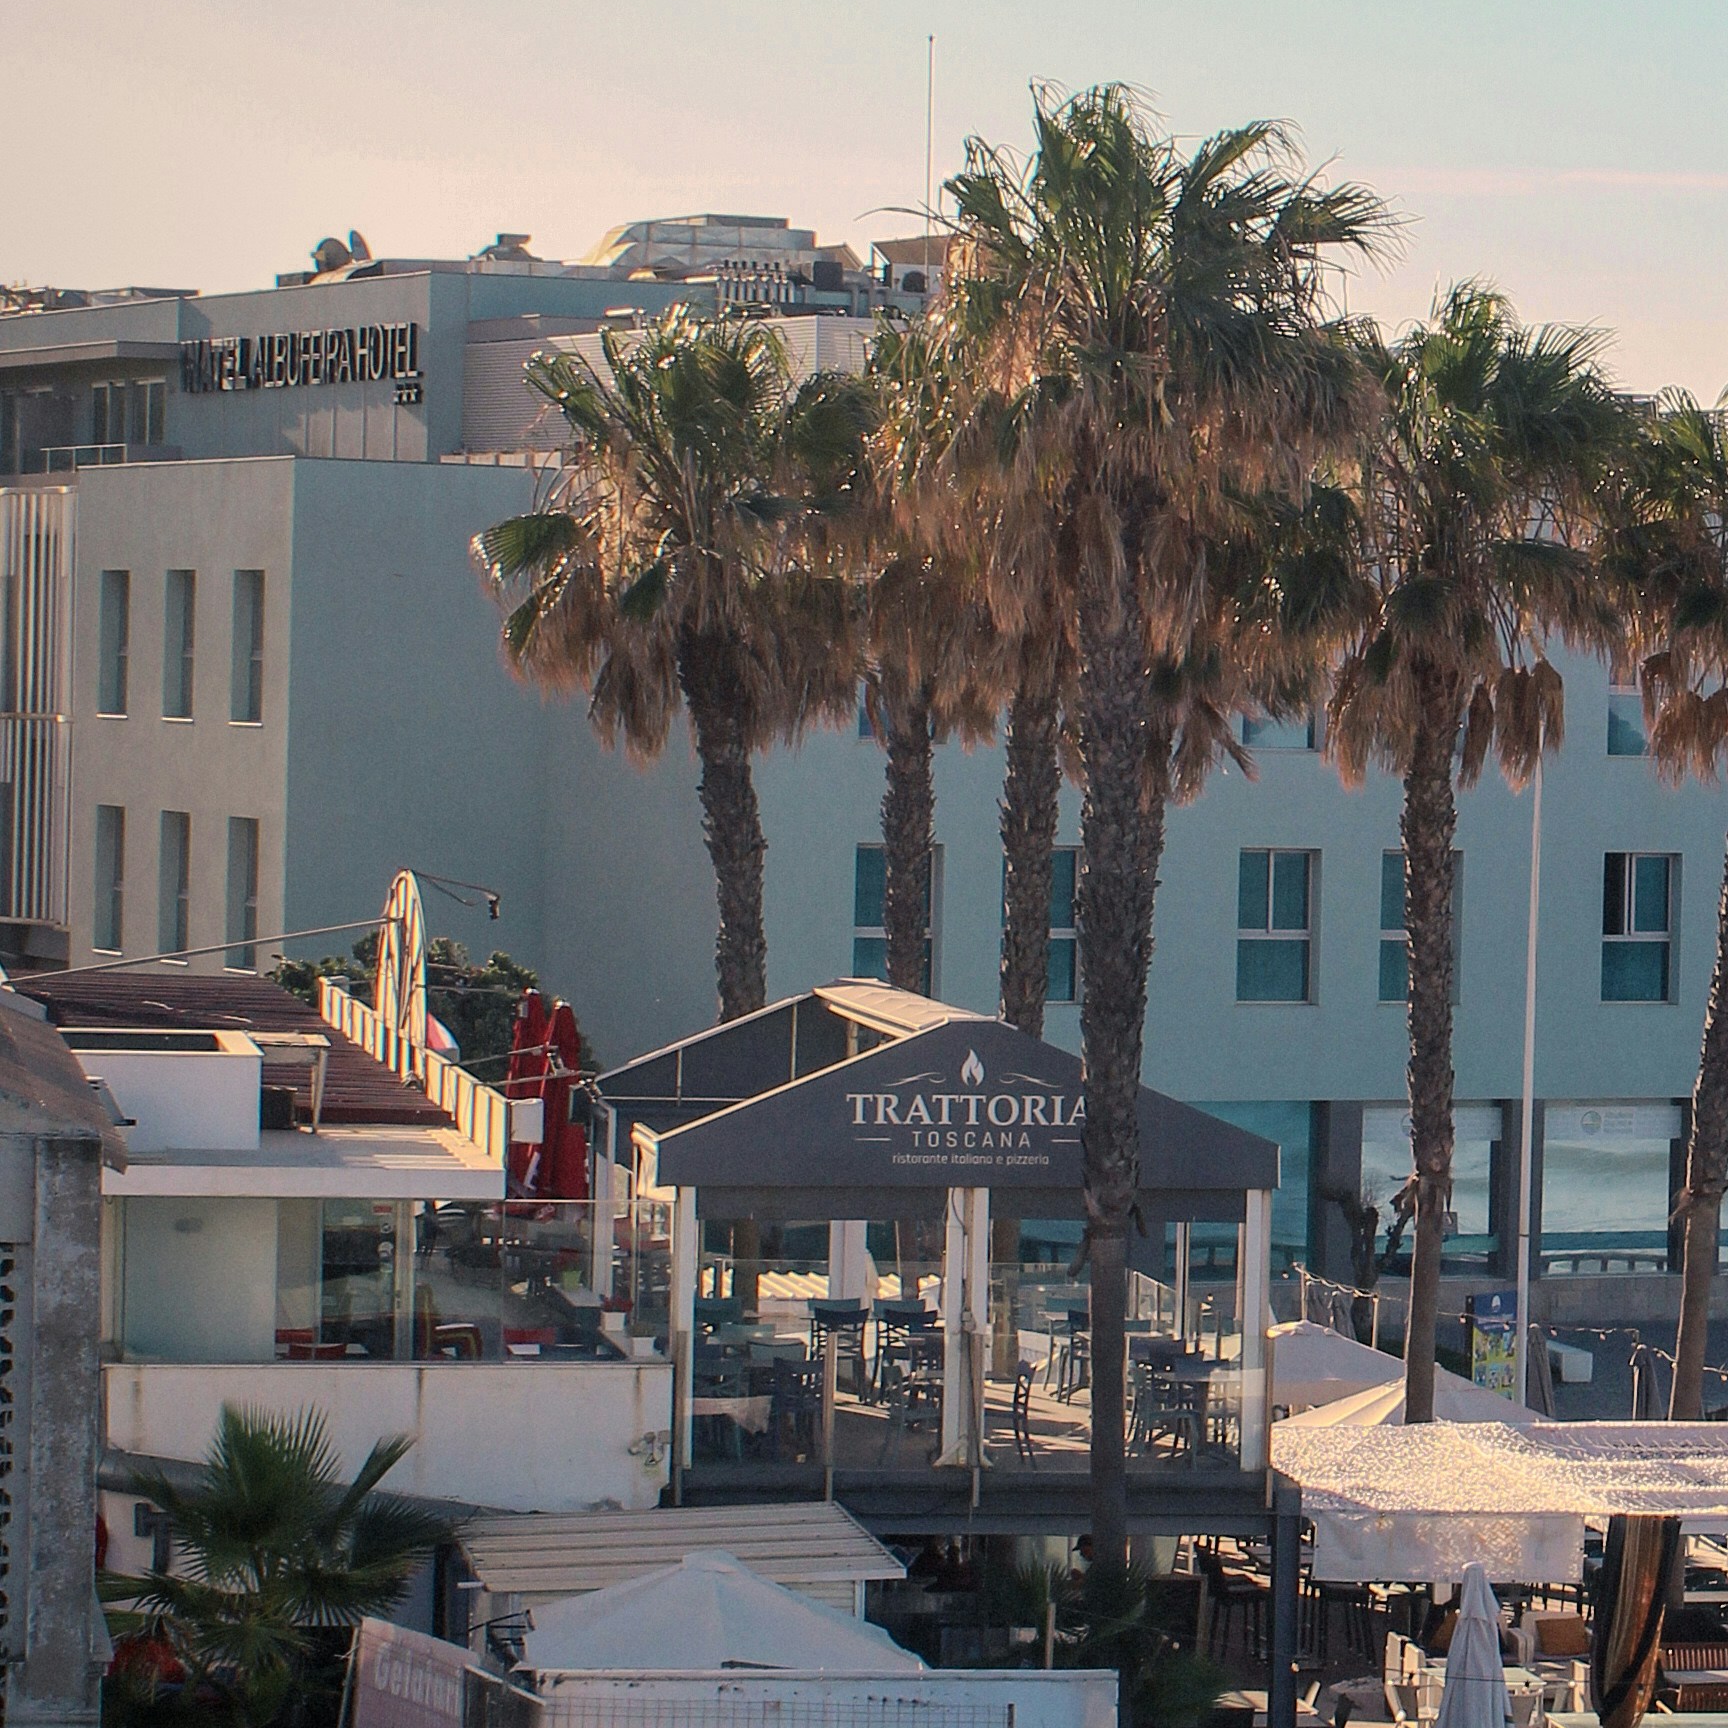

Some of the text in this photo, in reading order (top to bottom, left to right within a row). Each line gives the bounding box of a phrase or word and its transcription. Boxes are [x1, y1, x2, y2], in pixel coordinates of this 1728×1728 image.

[253, 328, 352, 388] ALBUFEIRA
[356, 322, 418, 380] HOTEL
[846, 1093, 1087, 1126] TRATTORIA
[911, 1130, 1031, 1148] TOSCANA
[892, 1153, 1050, 1167] ristorante italiano e pizzeria
